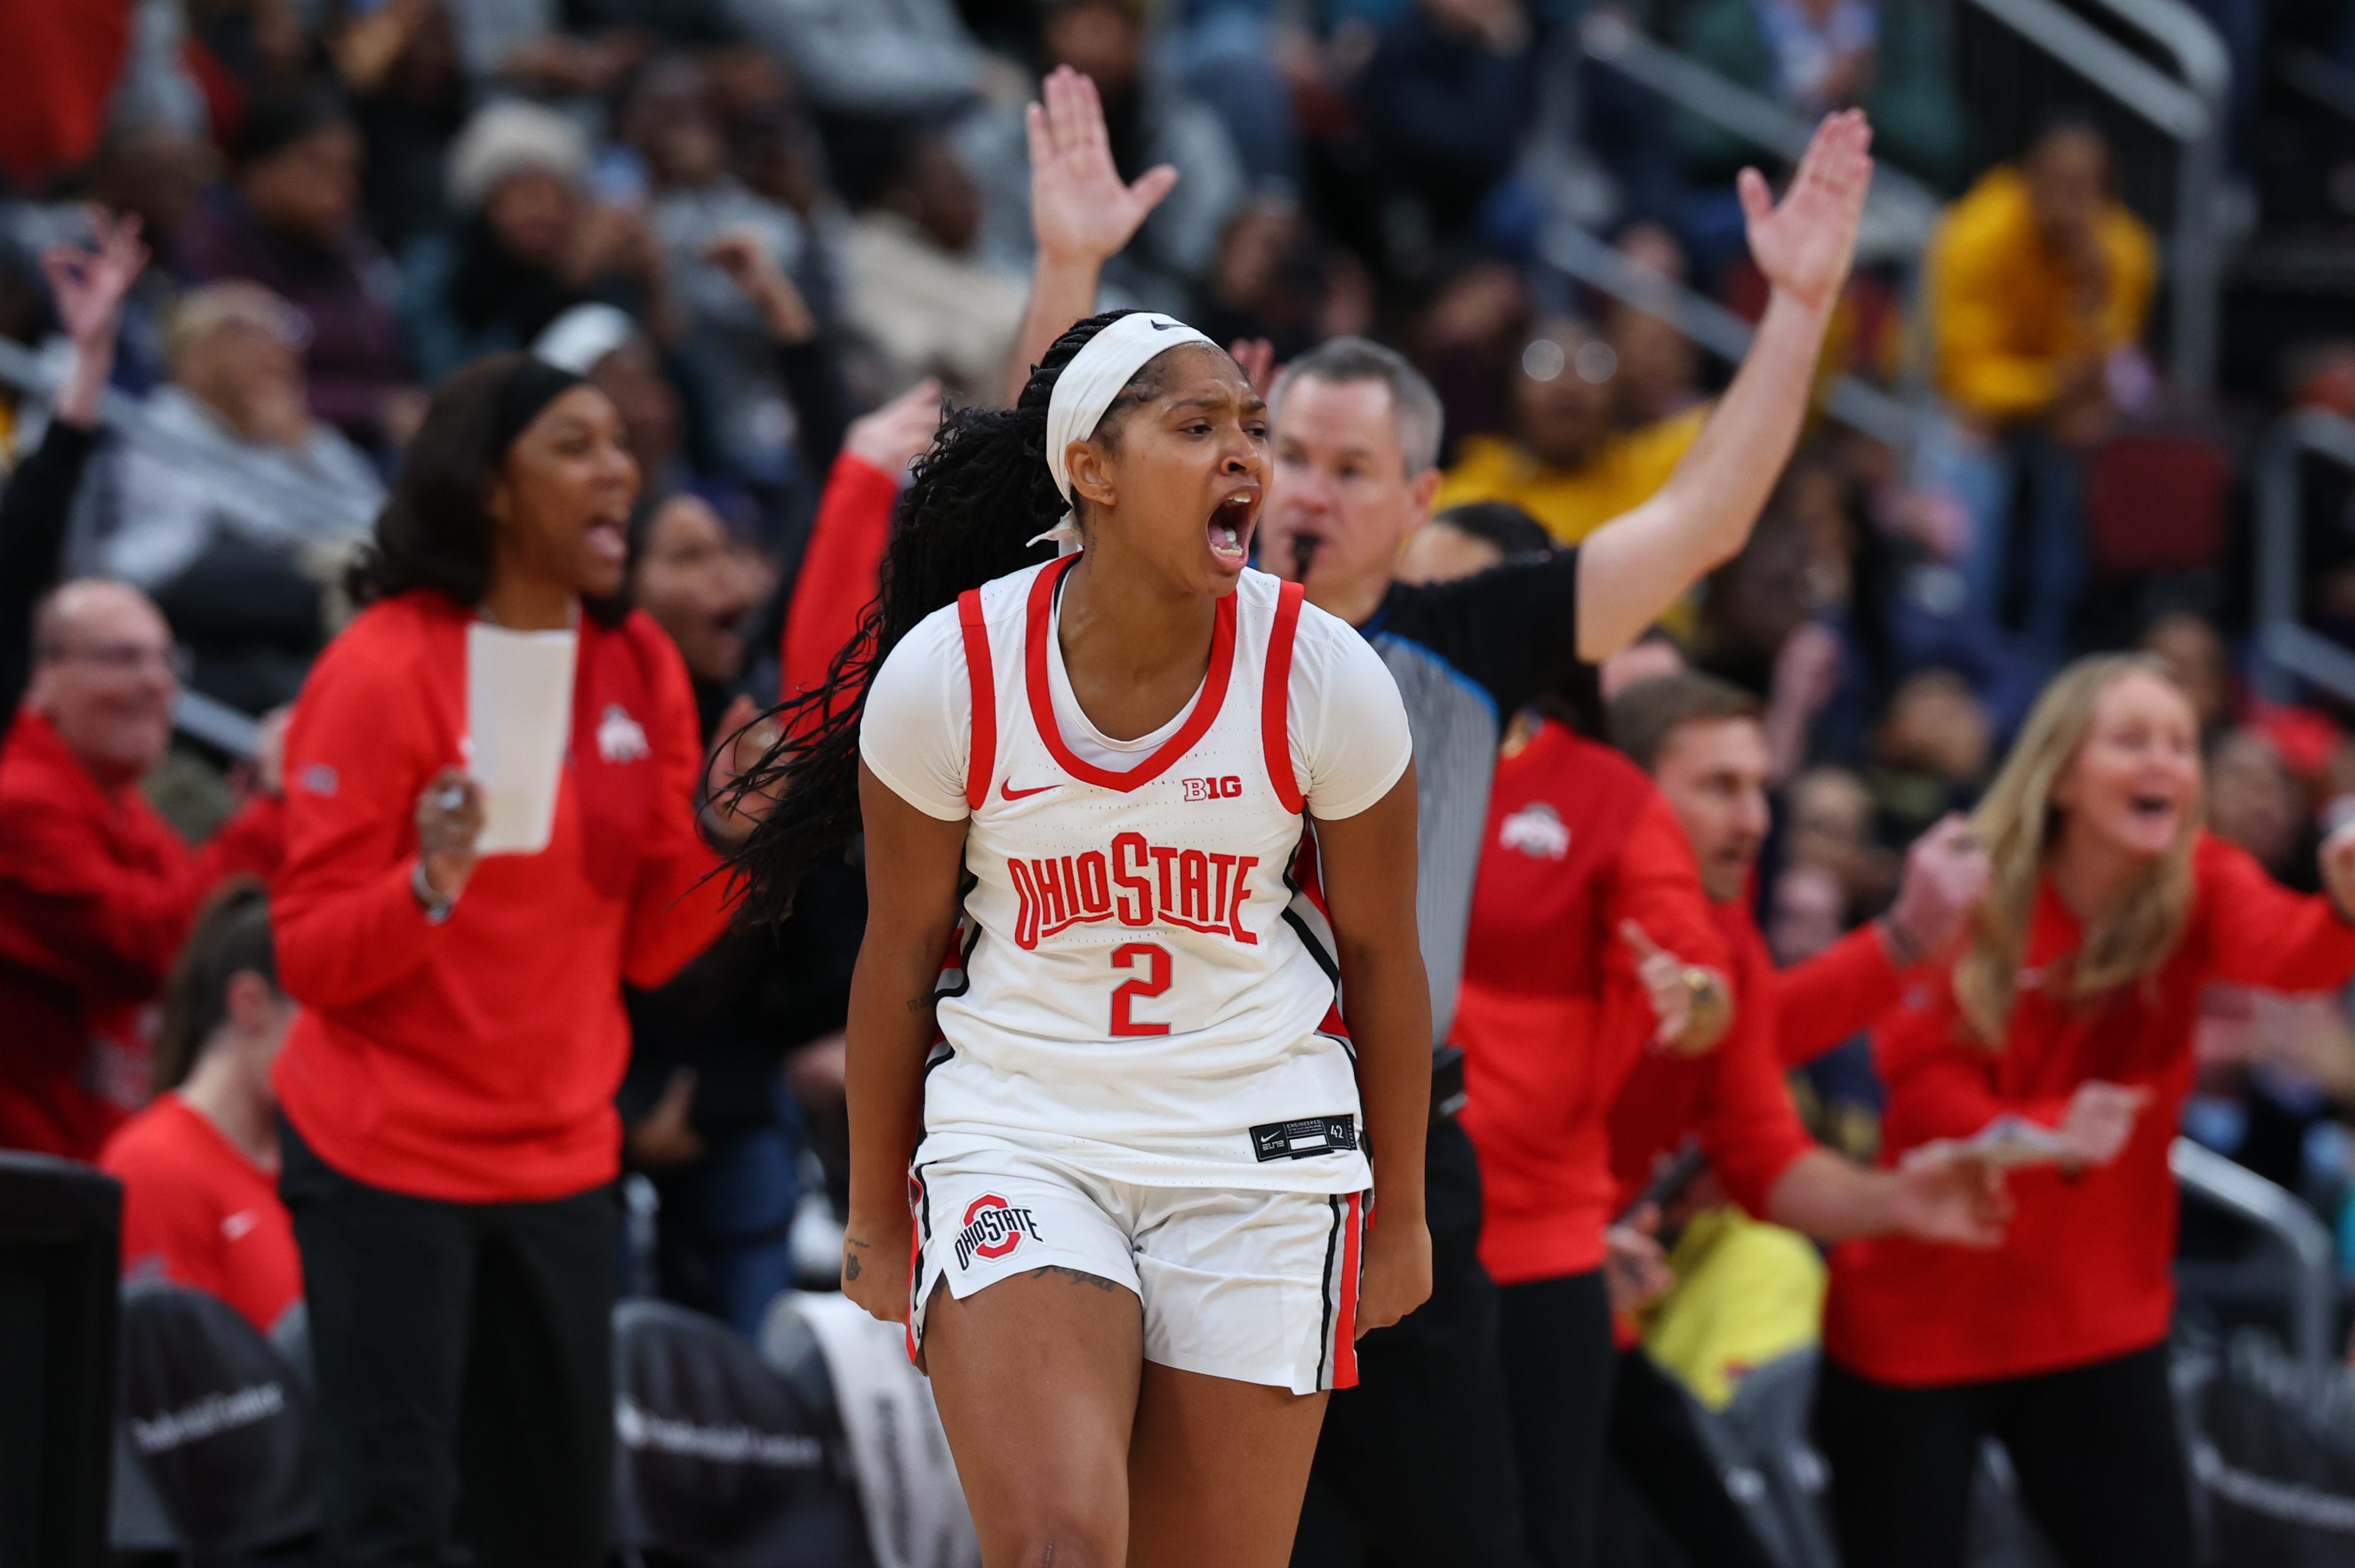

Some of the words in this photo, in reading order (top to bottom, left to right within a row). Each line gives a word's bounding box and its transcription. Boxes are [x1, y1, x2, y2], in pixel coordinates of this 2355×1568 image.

[1109, 943, 1173, 1037] 2
[1330, 1125, 1344, 1139] 42
[1262, 1140, 1285, 1151] ELITE
